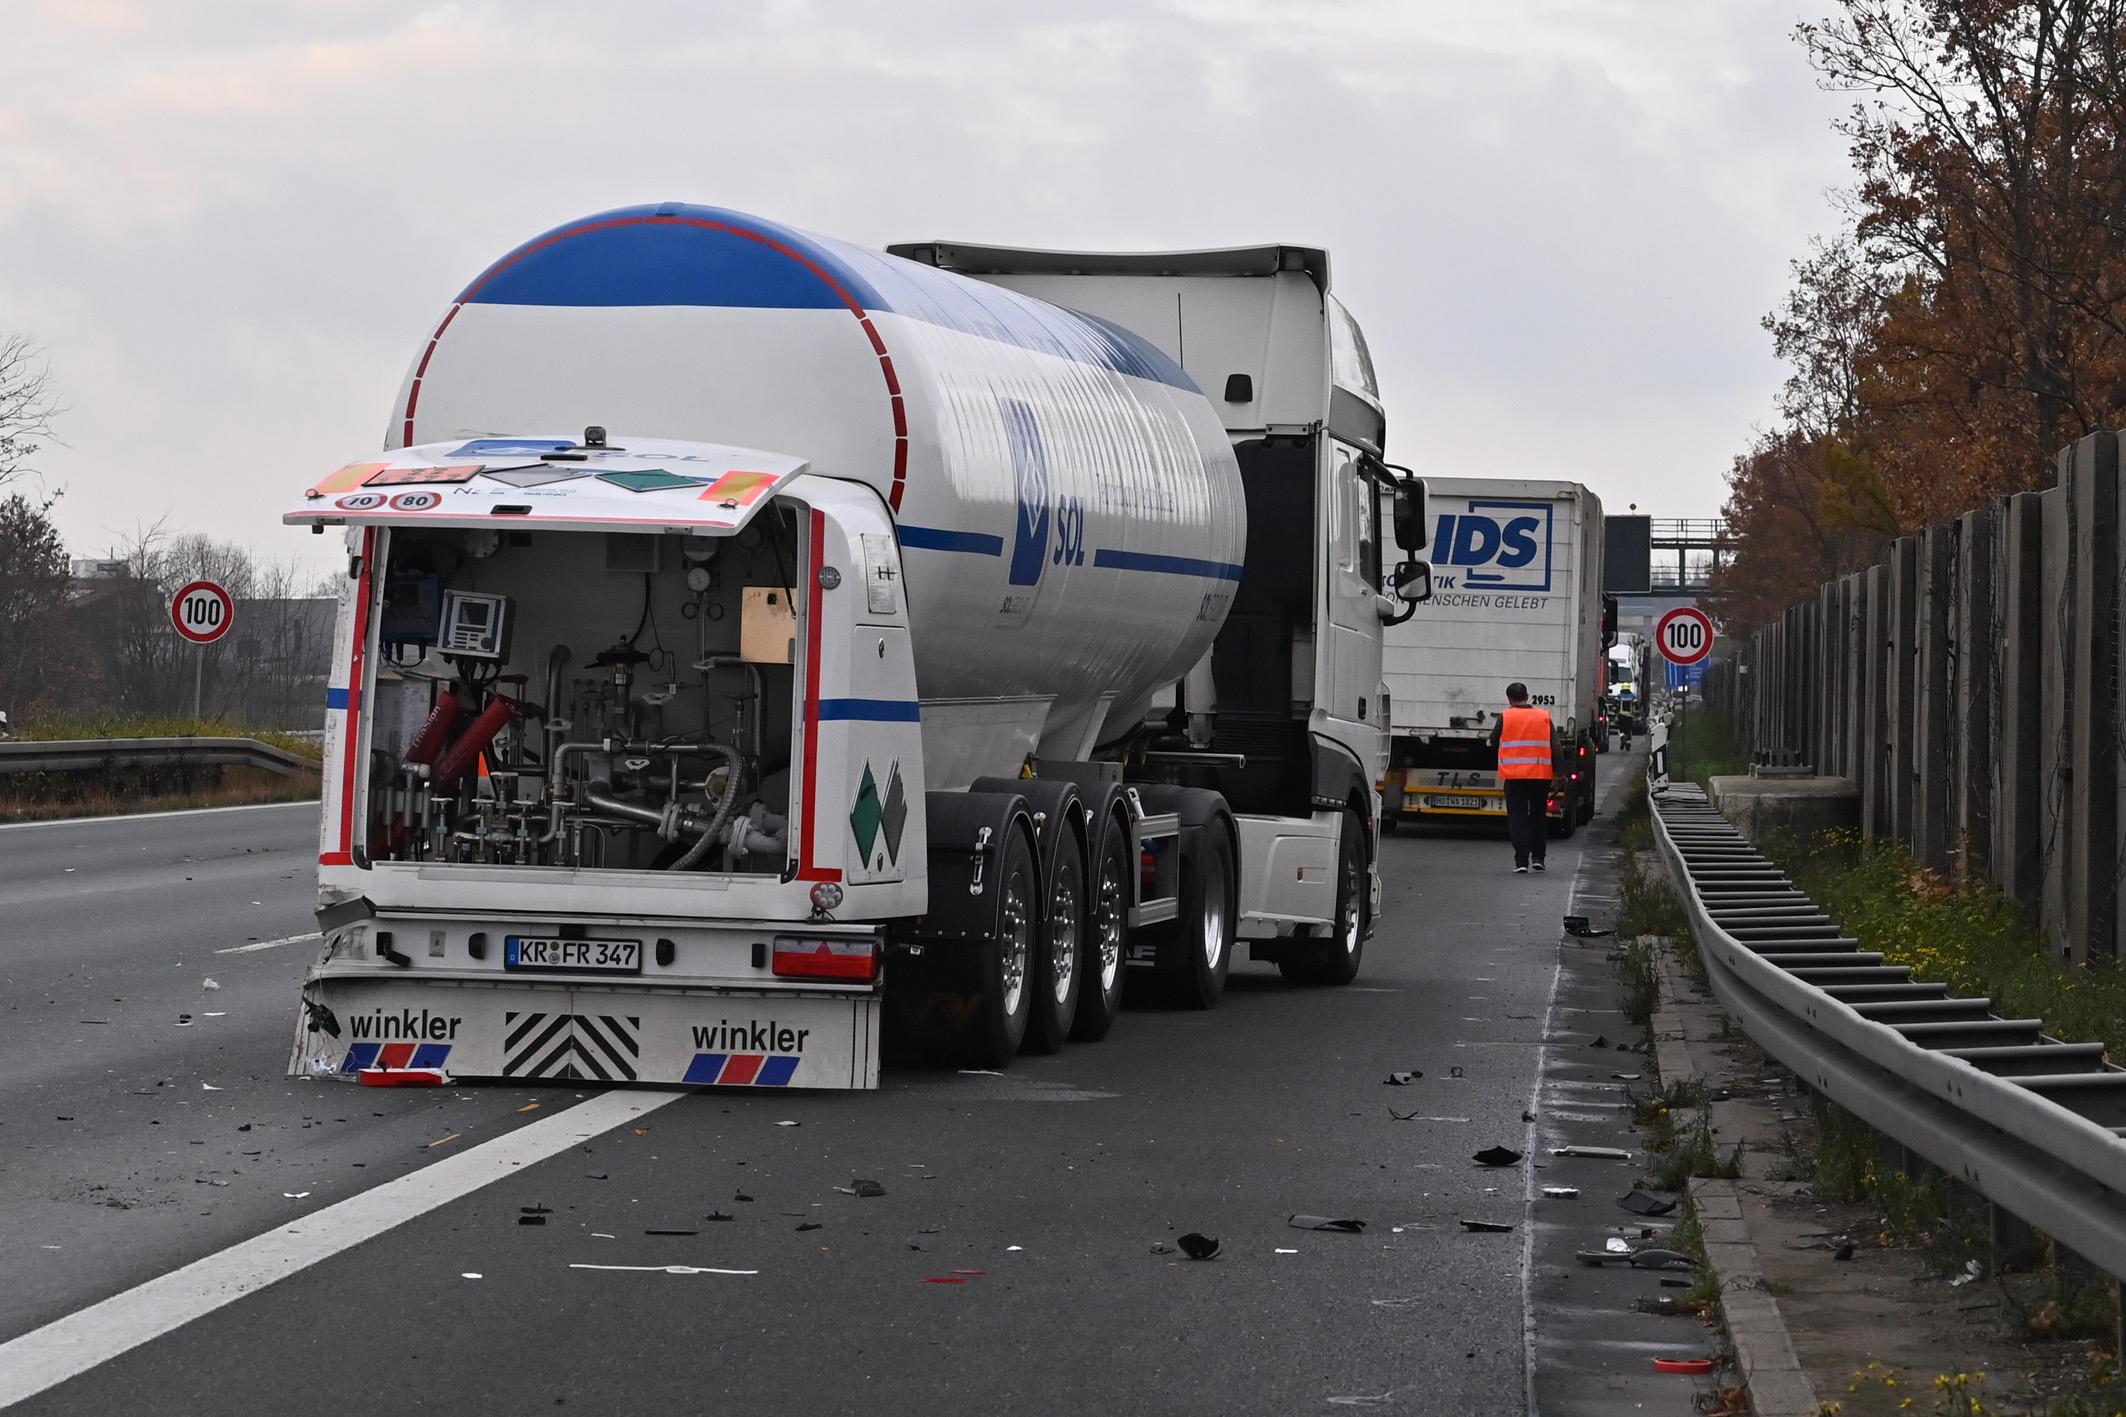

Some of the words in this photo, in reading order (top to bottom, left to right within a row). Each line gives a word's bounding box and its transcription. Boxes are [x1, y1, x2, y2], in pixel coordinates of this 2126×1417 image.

[402, 496, 429, 506] 80
[1053, 494, 1085, 567] SOL
[1430, 514, 1540, 568] IDS
[184, 597, 221, 626] 100
[1418, 593, 1491, 608] ENSCHEN
[1494, 595, 1549, 610] GELEBT
[1667, 623, 1702, 649] 100
[1531, 694, 1555, 706] 2953
[520, 941, 548, 963] KR
[562, 942, 590, 965] FR
[595, 943, 636, 966] 347
[350, 1008, 462, 1040] winkler
[692, 1019, 810, 1053] winkler
